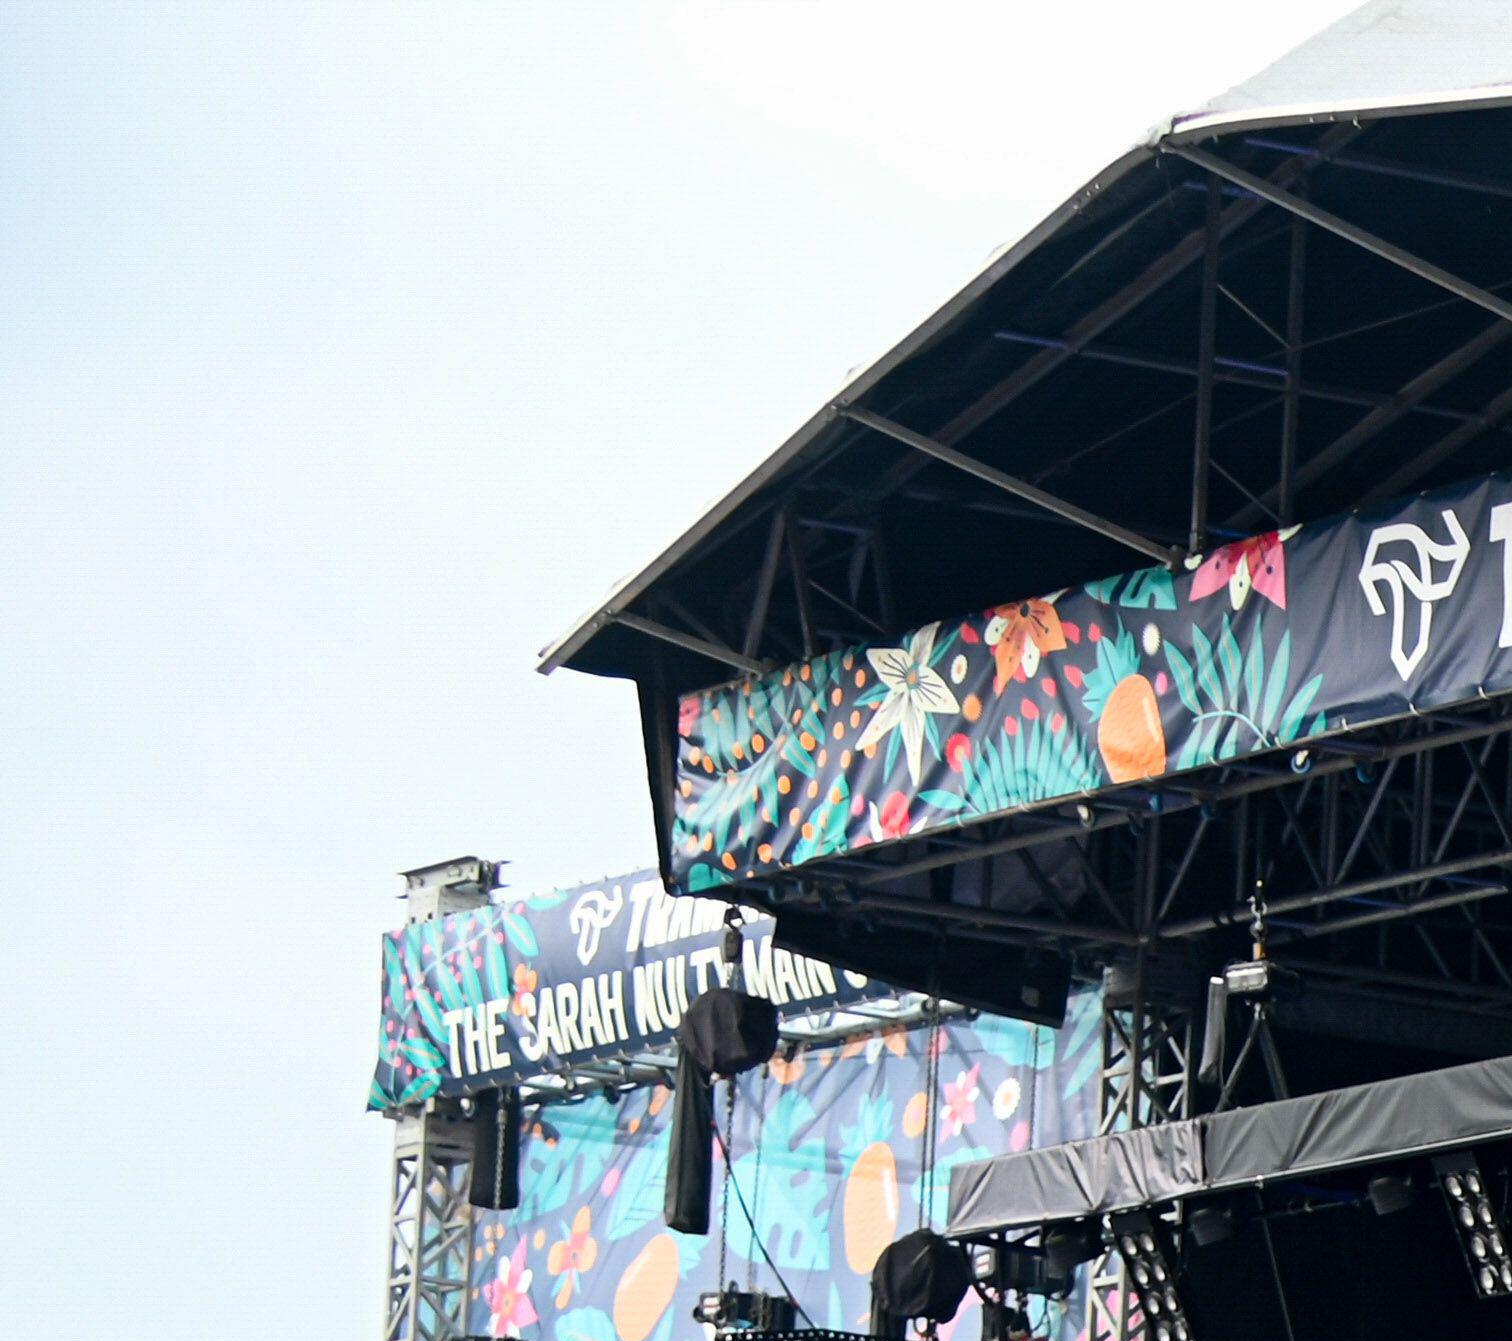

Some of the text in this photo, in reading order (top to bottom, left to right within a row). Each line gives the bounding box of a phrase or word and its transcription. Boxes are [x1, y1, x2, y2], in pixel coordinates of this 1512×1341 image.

[443, 998, 512, 1078] THE
[518, 970, 628, 1062] SARAH
[743, 935, 837, 1006] MAIN
